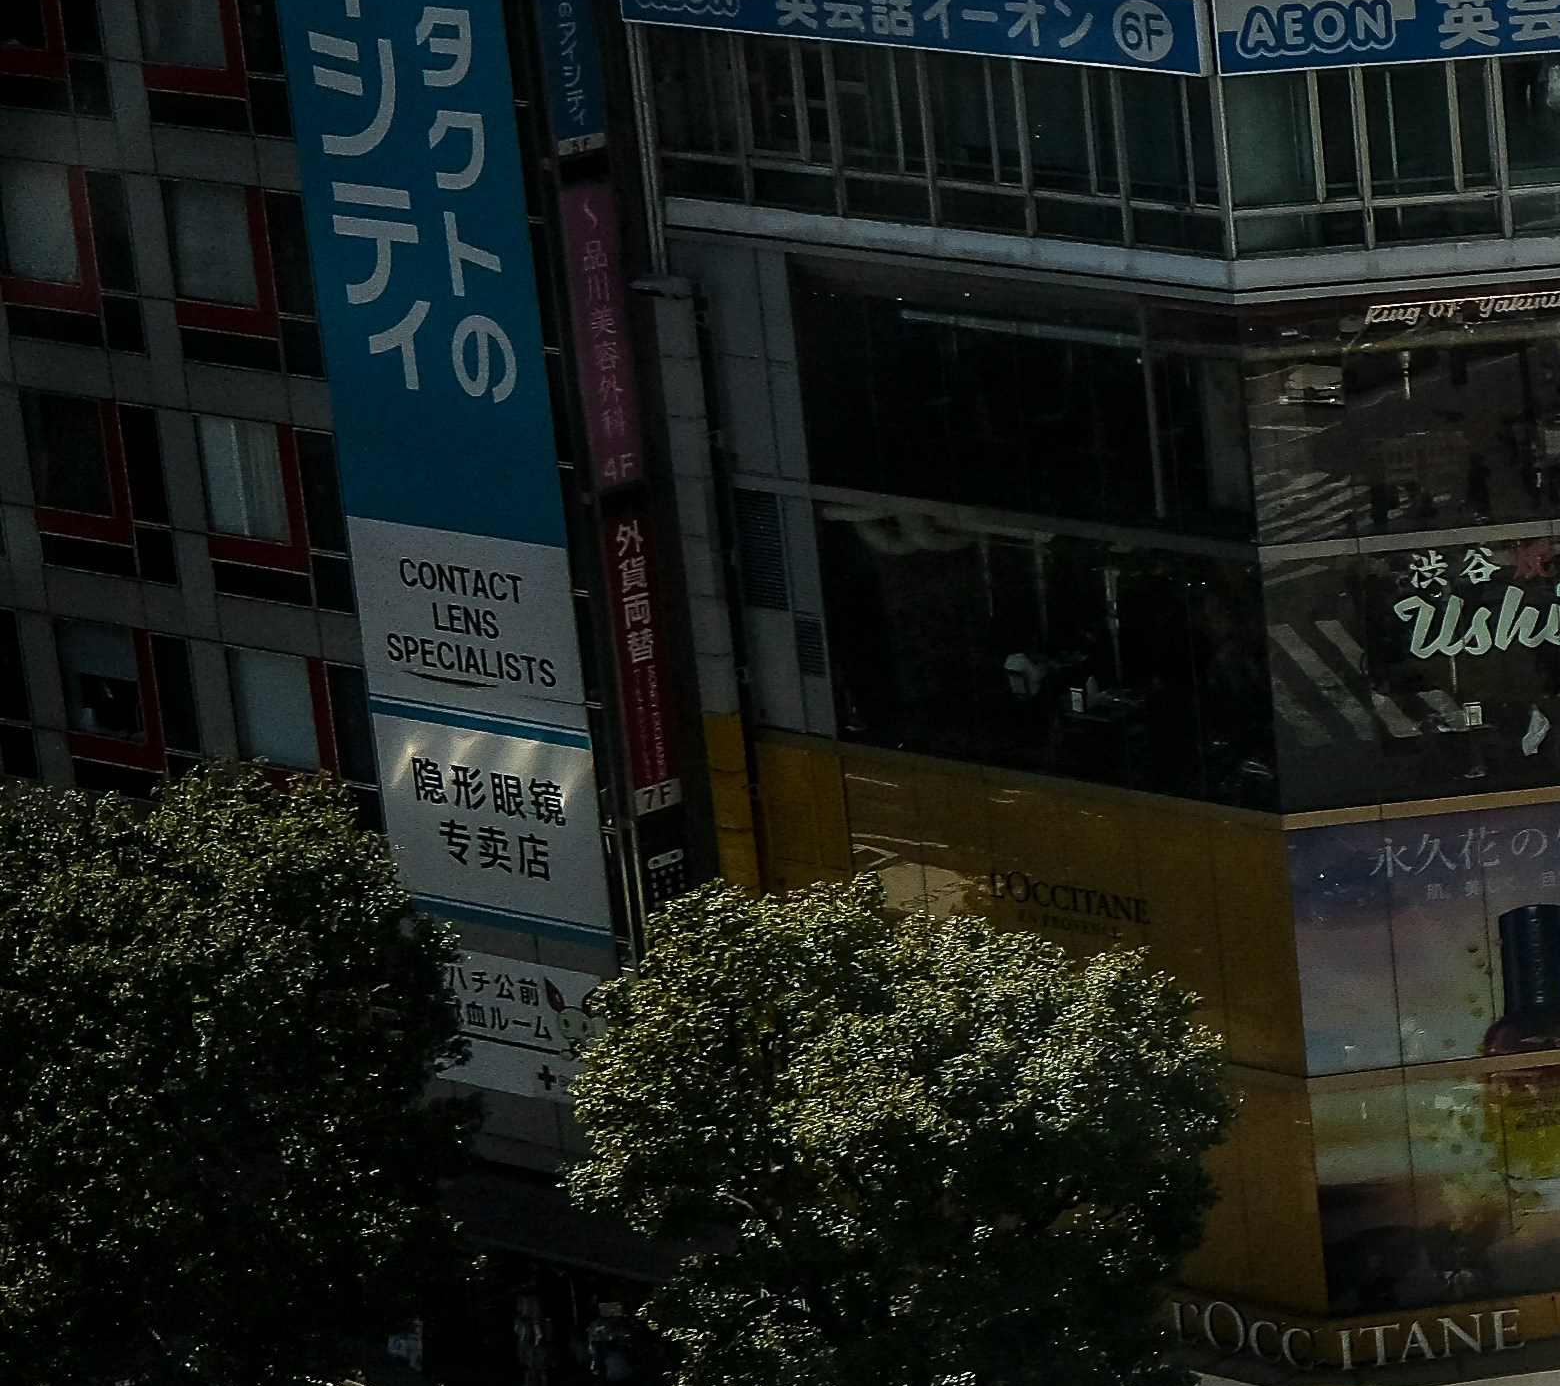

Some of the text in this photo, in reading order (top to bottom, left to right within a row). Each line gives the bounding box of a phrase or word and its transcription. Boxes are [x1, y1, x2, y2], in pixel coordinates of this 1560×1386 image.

[1117, 8, 1169, 53] 6F
[1241, 2, 1394, 56] AEON
[399, 555, 524, 605] CONTACT
[614, 517, 656, 667] 外貨両替
[1409, 546, 1502, 590] 渋谷
[431, 601, 501, 639] LENS
[386, 632, 557, 689] SPECIALISTS
[411, 755, 568, 827] 隐形眼镜
[643, 785, 673, 812] 7F
[438, 818, 552, 883] 专卖店
[1170, 1299, 1528, 1373] L'OCCITANE
